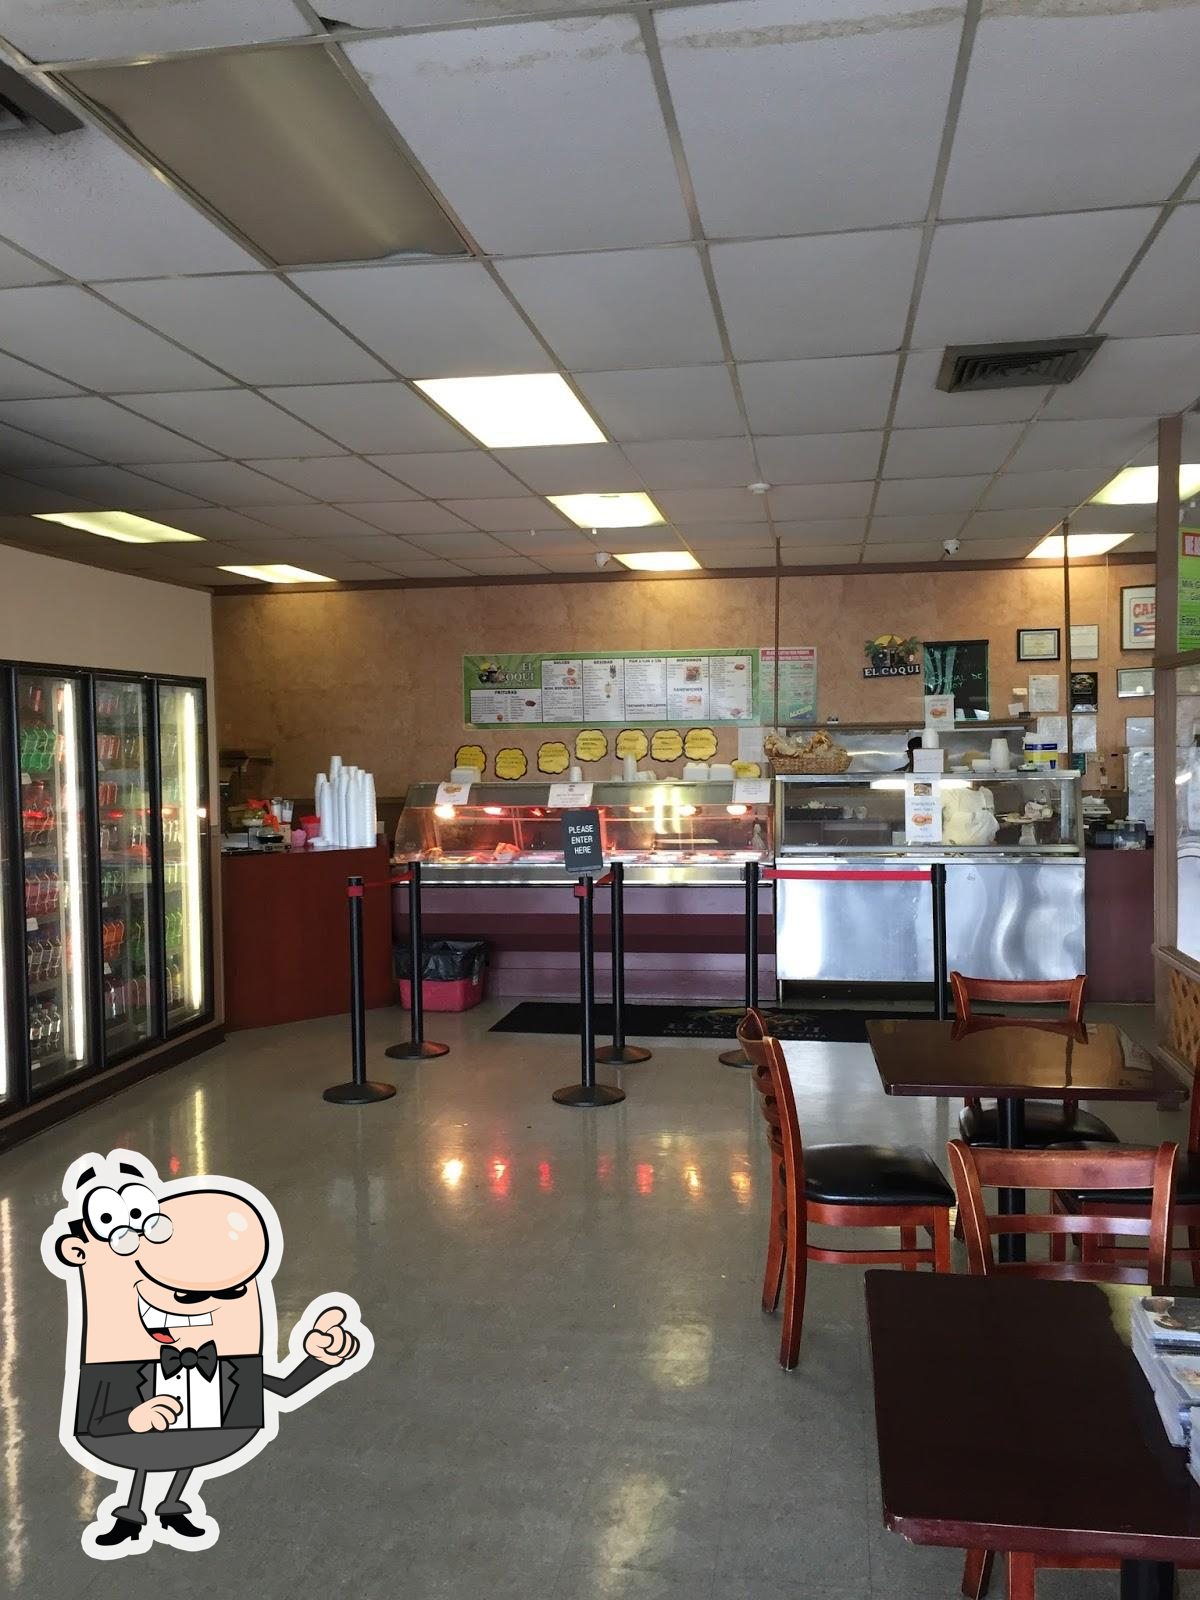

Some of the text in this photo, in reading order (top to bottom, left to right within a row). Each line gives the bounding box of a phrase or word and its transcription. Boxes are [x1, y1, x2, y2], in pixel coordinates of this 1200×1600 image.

[864, 665, 920, 676] EL COQUI
[568, 824, 594, 834] PLEASE
[571, 835, 593, 845] ENTER
[574, 846, 592, 855] HERE
